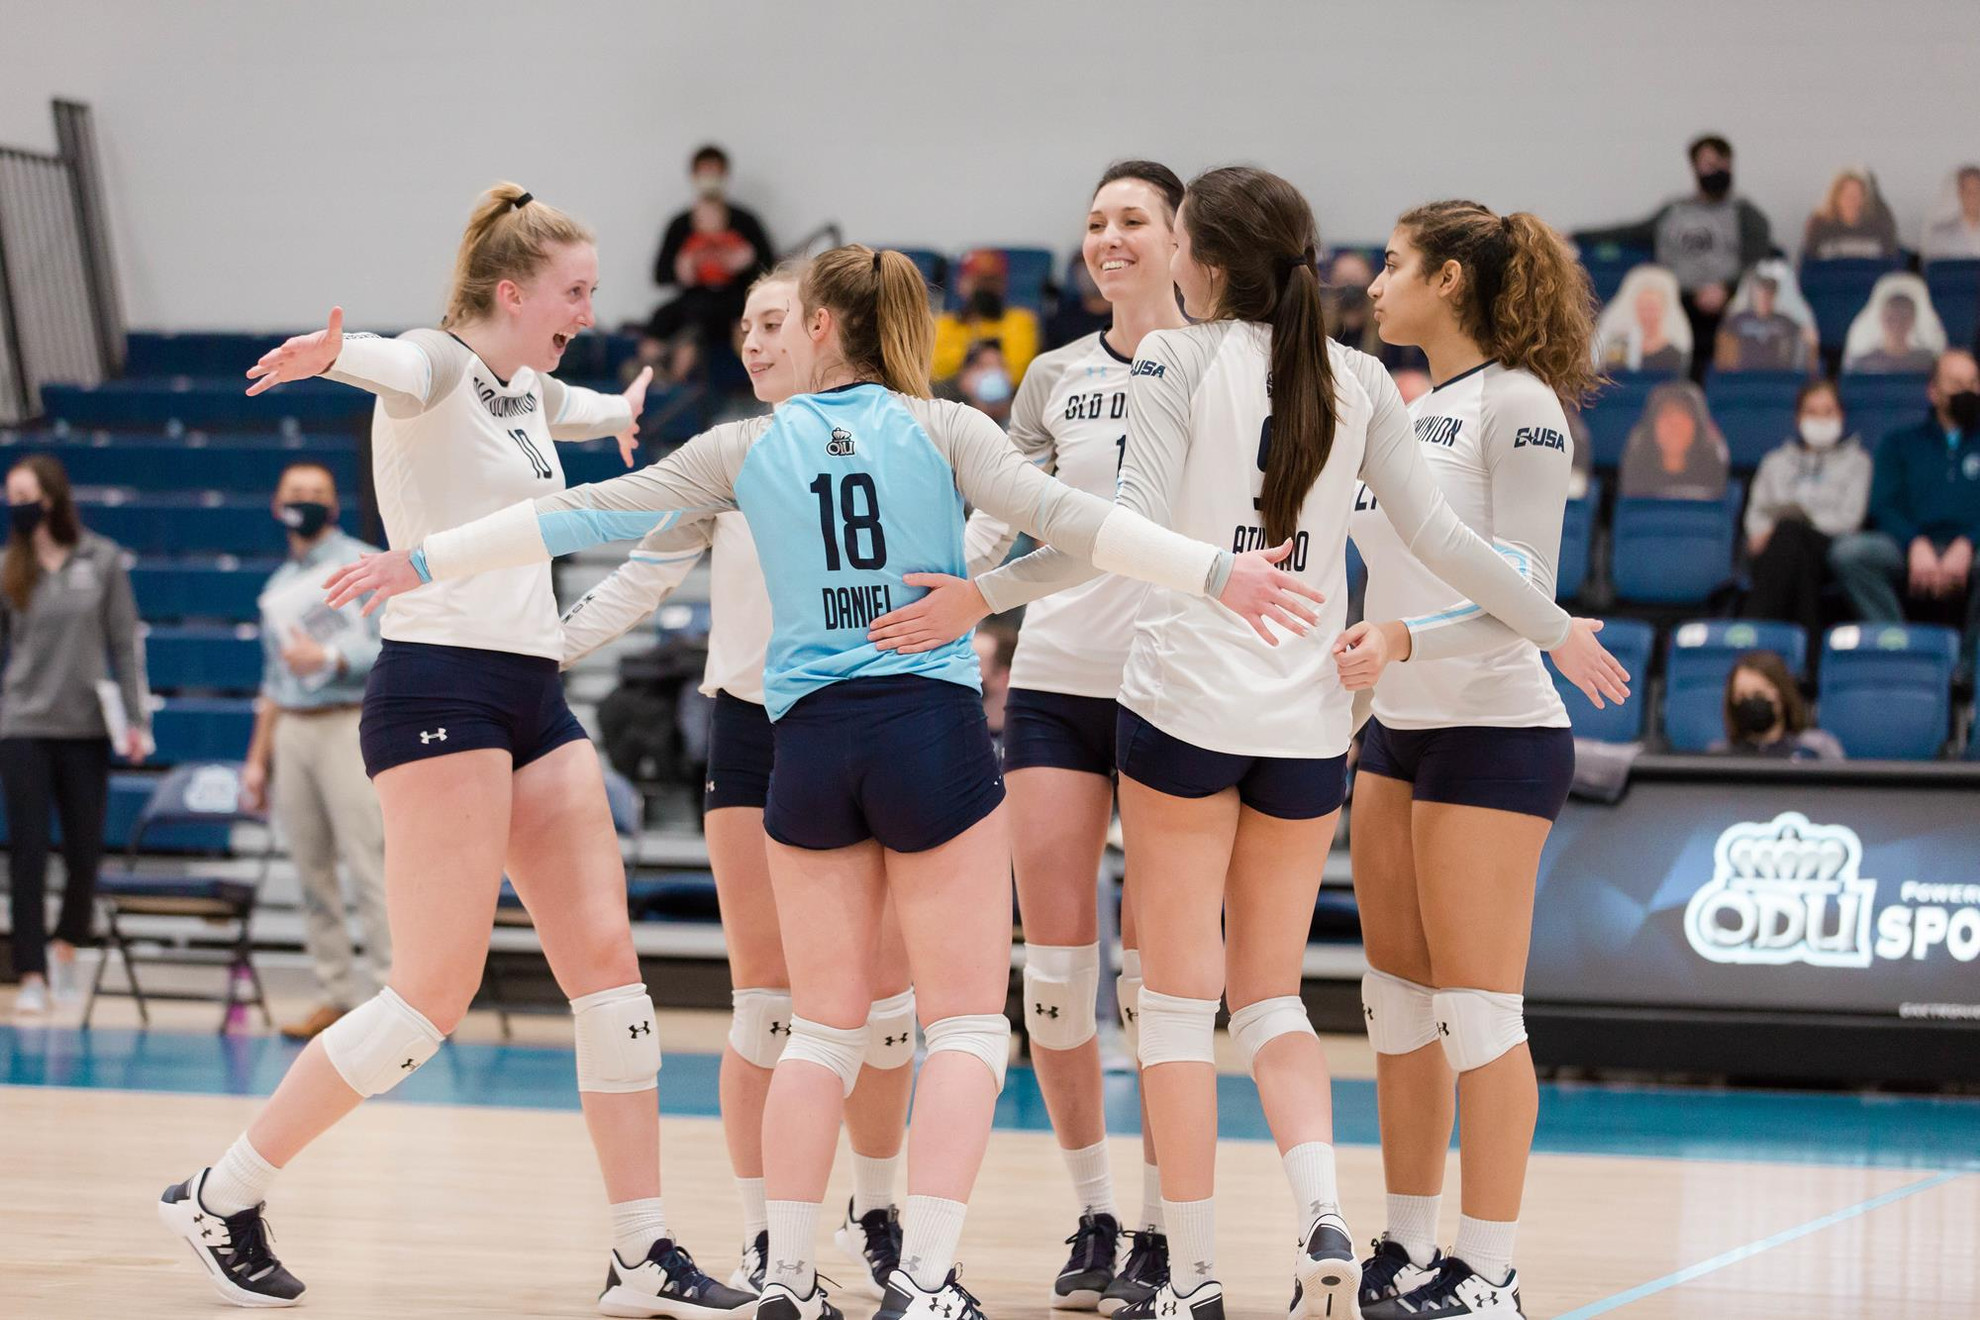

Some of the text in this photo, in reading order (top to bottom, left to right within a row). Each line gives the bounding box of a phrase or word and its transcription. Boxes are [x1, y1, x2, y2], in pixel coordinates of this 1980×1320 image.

[1130, 359, 1166, 378] USA
[1065, 393, 1103, 420] OLD
[507, 429, 552, 479] 10
[810, 472, 887, 571] 18
[1901, 880, 1980, 904] POWER
[1694, 887, 1863, 955] ODU
[1875, 905, 1980, 962] SPO
